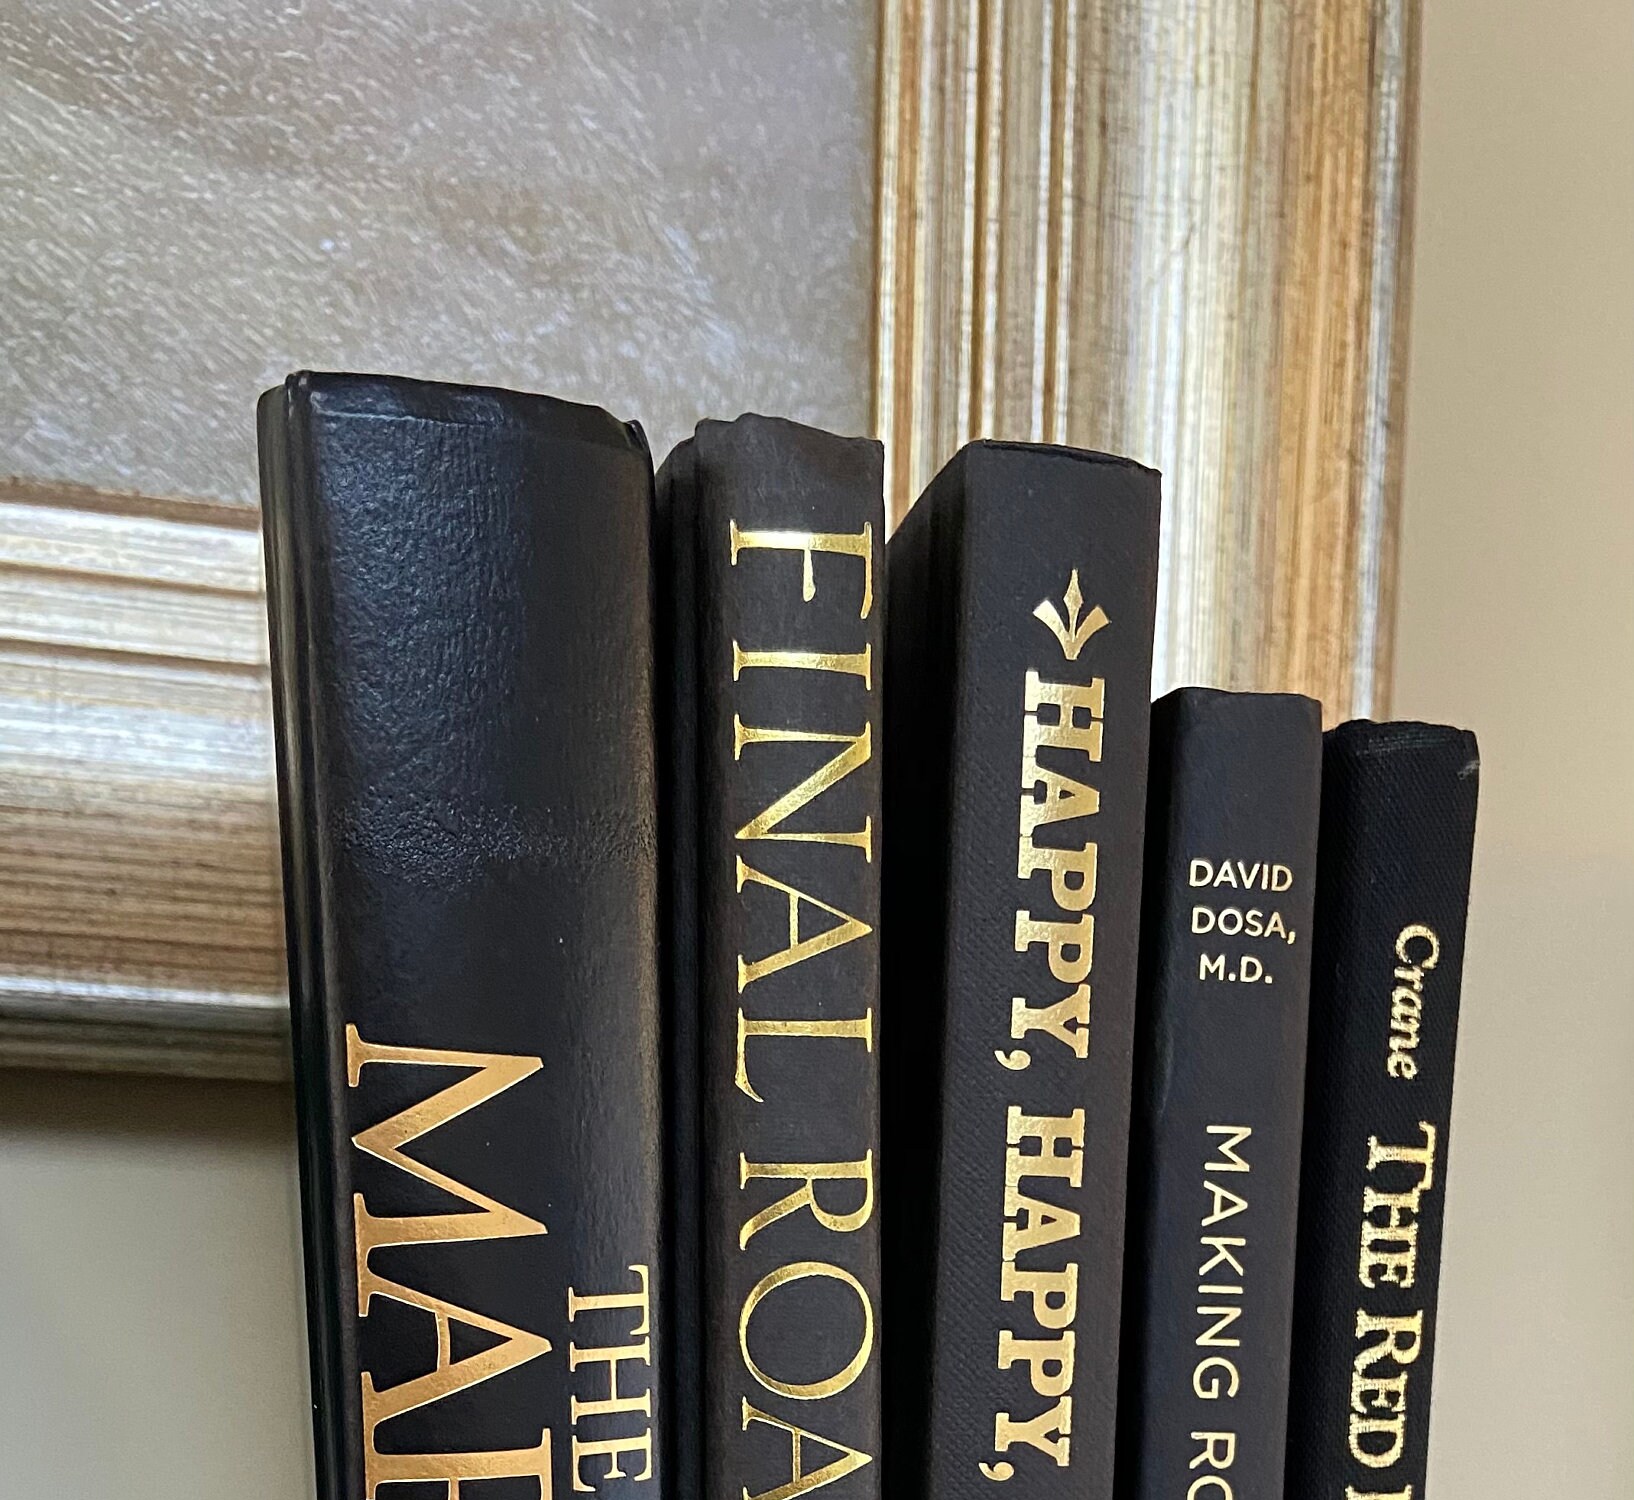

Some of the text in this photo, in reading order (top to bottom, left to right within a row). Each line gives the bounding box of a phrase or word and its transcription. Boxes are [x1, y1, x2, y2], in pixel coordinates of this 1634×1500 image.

[729, 519, 874, 1102] FINAL
[994, 668, 1105, 1071] HAPPY,
[1188, 858, 1293, 892] DAVID
[1191, 905, 1296, 944] DOSA,
[1199, 953, 1273, 985] M.D.
[1386, 923, 1441, 1080] Crane
[1193, 1124, 1253, 1400] MAKING
[1358, 1120, 1437, 1290] THE
[568, 1264, 653, 1493] THE
[979, 1105, 1085, 1482] HAPPY,
[1346, 1307, 1425, 1470] RED
